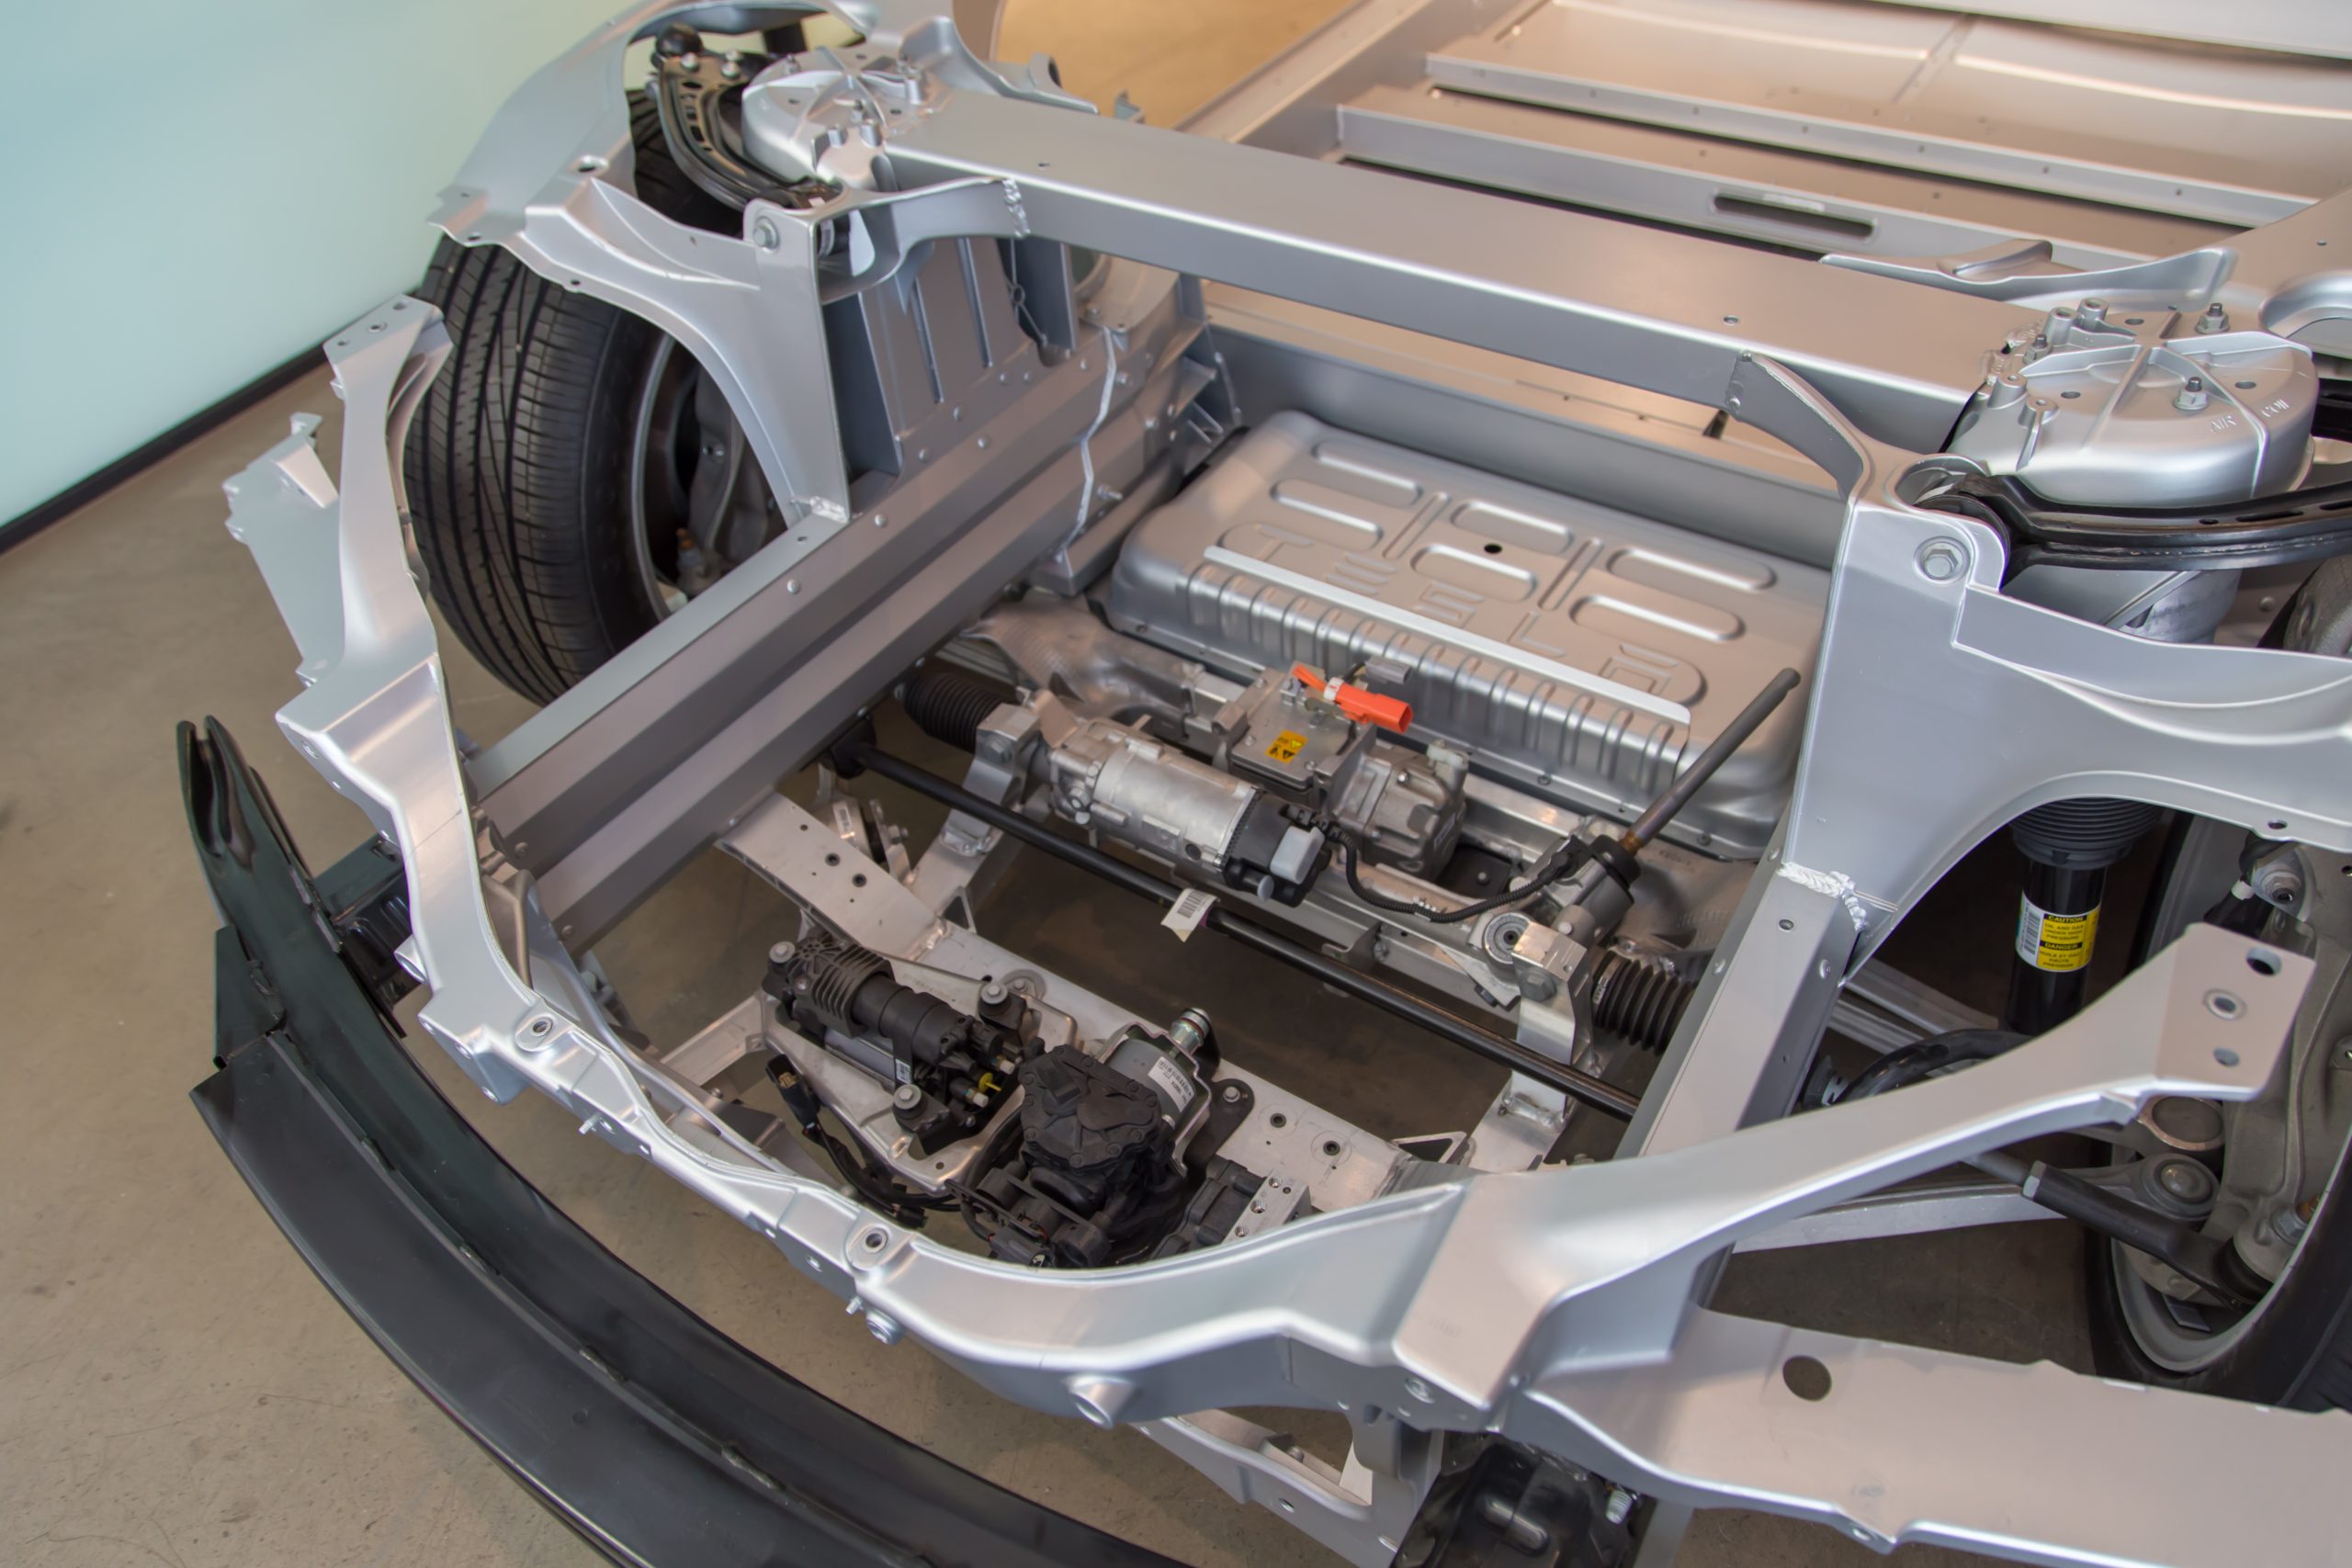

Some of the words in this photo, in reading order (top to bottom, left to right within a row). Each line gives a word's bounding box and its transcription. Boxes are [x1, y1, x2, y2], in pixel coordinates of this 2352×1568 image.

[2210, 414, 2236, 434] AIR
[1254, 522, 1680, 696] TESLA
[2048, 915, 2084, 923] CAUTION
